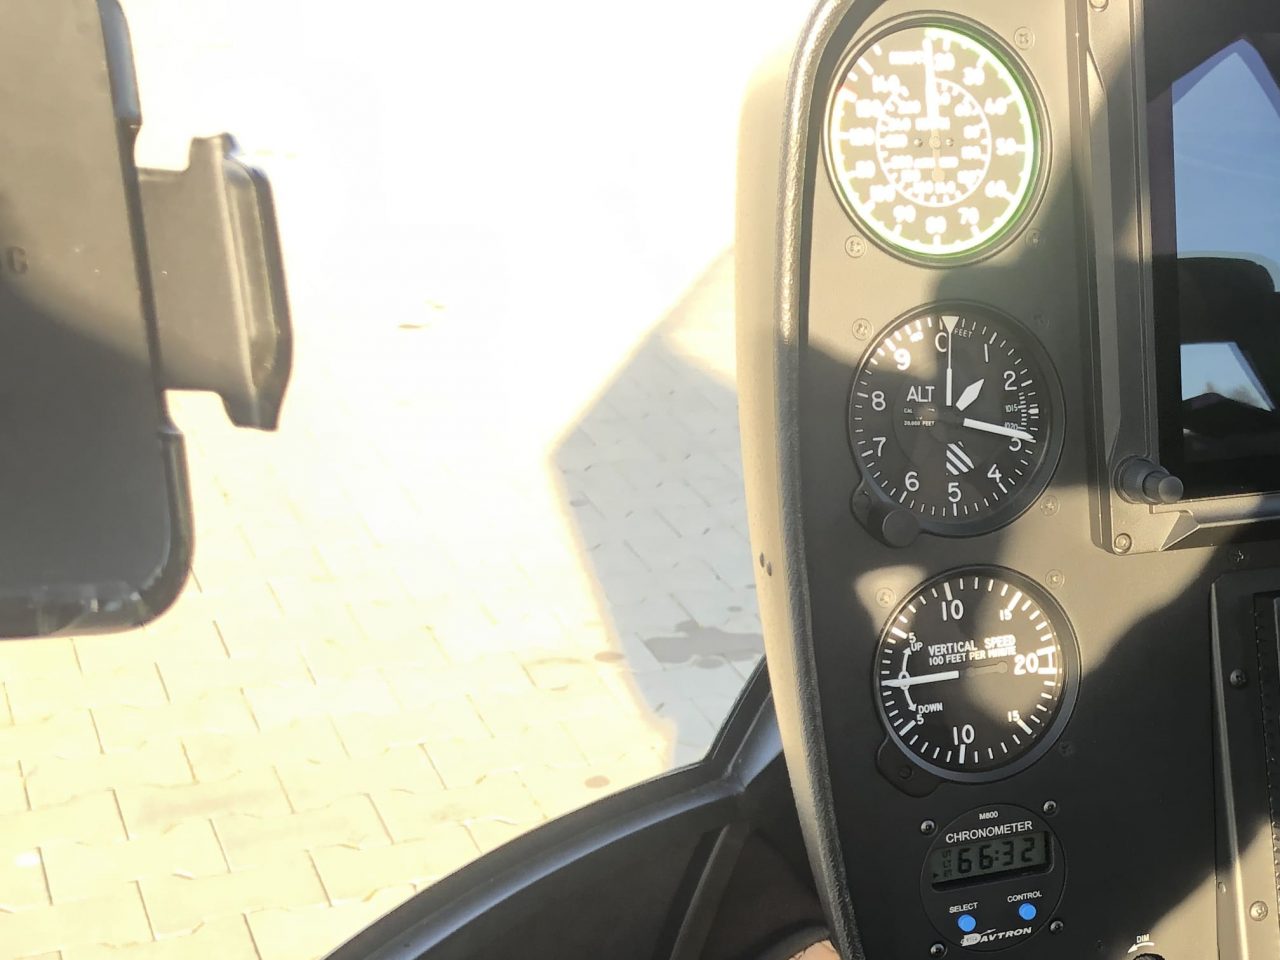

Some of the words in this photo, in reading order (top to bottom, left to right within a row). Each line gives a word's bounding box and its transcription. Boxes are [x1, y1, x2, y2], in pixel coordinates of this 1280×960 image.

[894, 348, 911, 371] 9
[1003, 371, 1018, 392] 2
[871, 391, 887, 411] 8
[906, 385, 935, 403] ALT
[872, 437, 887, 457] 7
[905, 472, 920, 491] 6
[987, 463, 1002, 483] 4
[948, 482, 962, 502] 5
[941, 600, 964, 621] 10
[1000, 609, 1012, 621] 15
[911, 642, 924, 652] UP
[928, 640, 978, 656] VERTICAL
[984, 634, 1016, 649] SPEED
[929, 655, 944, 666] 100
[945, 652, 967, 664] FEET
[969, 650, 986, 661] PER
[1014, 652, 1039, 675] 20
[918, 703, 943, 714] DOWN
[1008, 710, 1020, 722] 15
[953, 724, 975, 745] 10
[945, 820, 1033, 844] CHRONOMETER
[949, 902, 979, 913] SELECT
[1007, 890, 1042, 903] CONTROL
[961, 927, 1032, 947] DAVTRON
[1137, 934, 1150, 944] DIM
